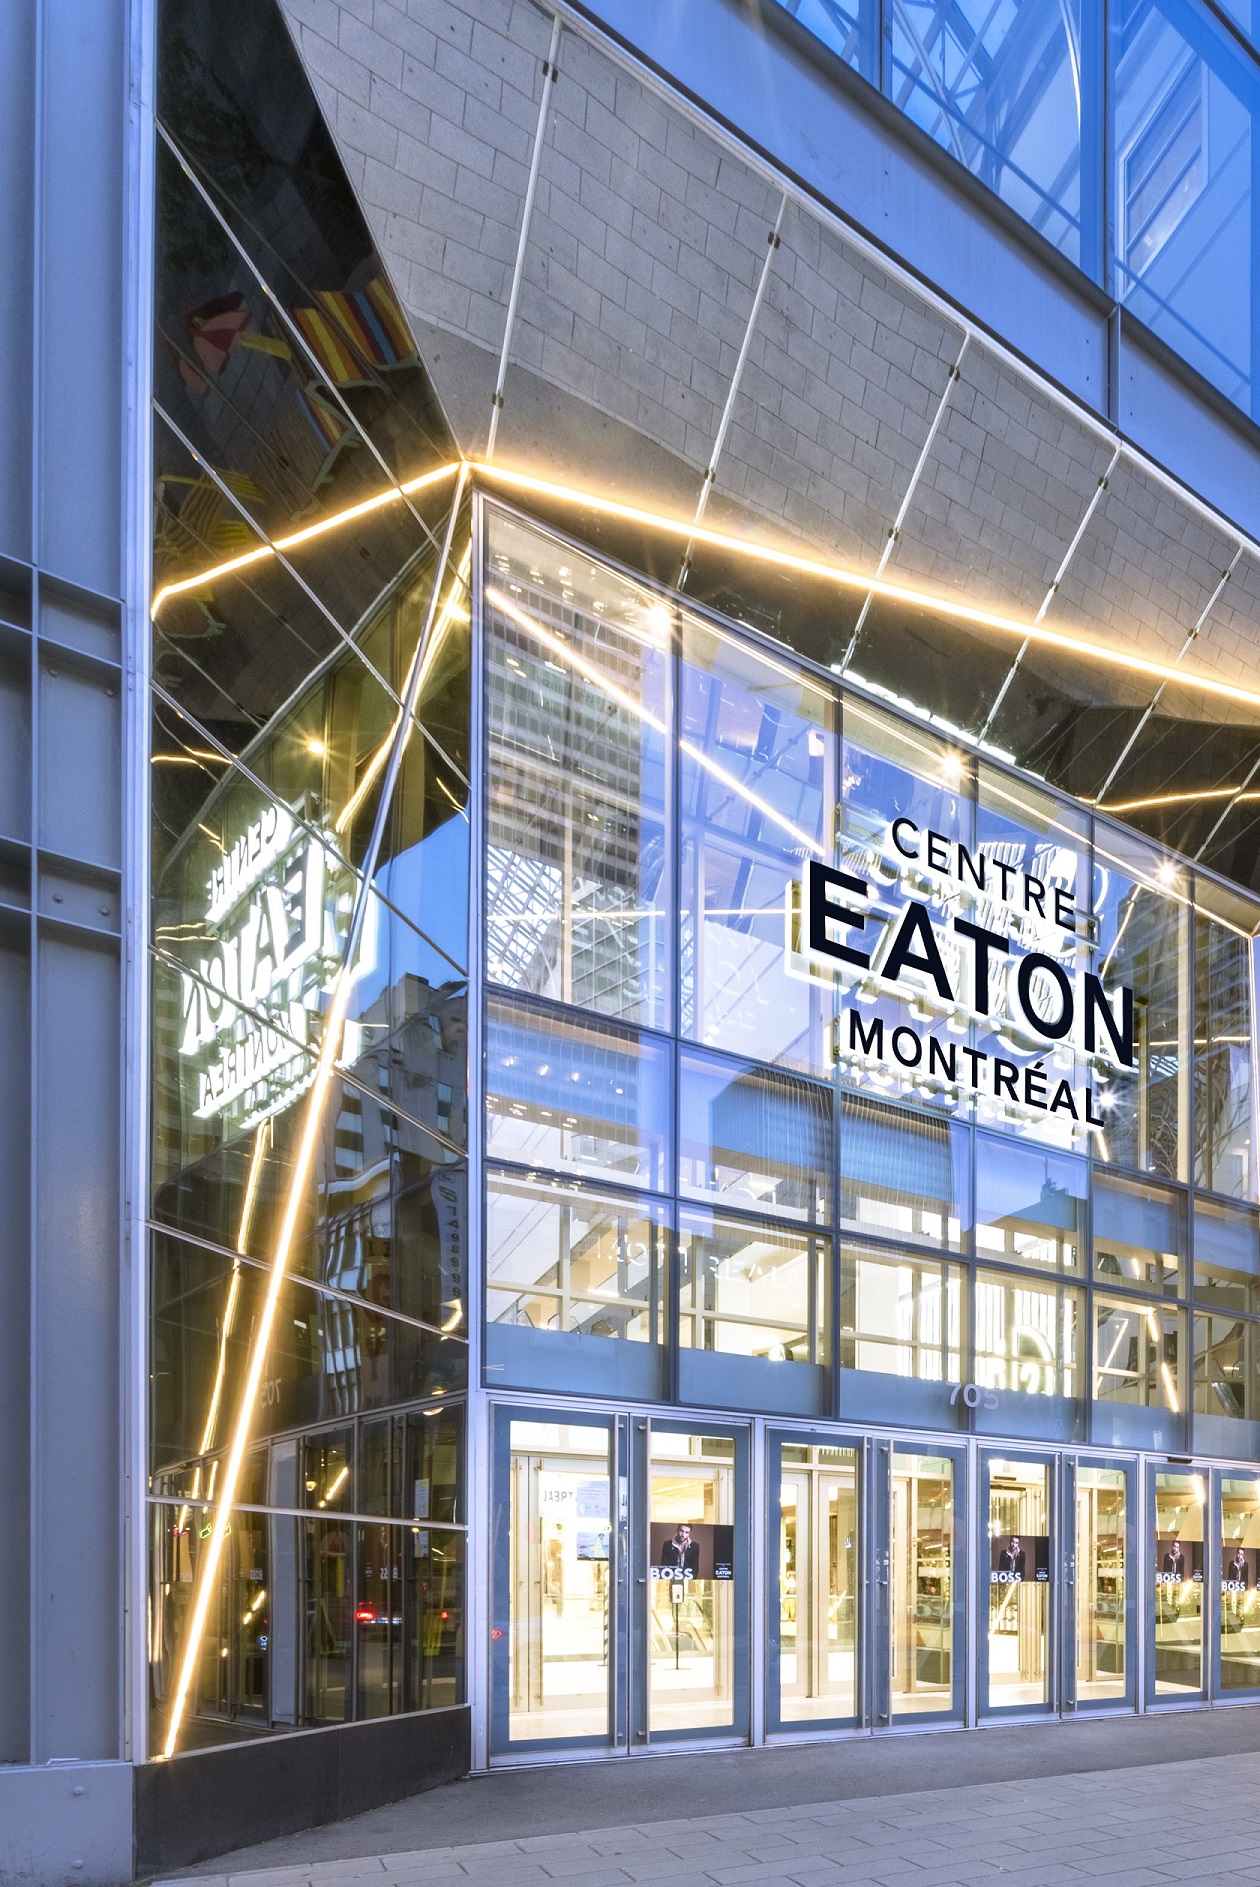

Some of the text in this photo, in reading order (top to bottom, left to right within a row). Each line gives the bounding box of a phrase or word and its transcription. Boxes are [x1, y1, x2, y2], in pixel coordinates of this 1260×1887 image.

[891, 817, 1076, 932] CENTRE
[809, 860, 1134, 1067] EATON
[848, 1008, 1104, 1128] MONTRÉAL
[945, 1382, 1000, 1410] 705
[650, 1568, 694, 1580] BOSS
[991, 1572, 1022, 1582] BOSS
[1157, 1573, 1181, 1583] BOSS
[1221, 1581, 1246, 1591] BOSS
